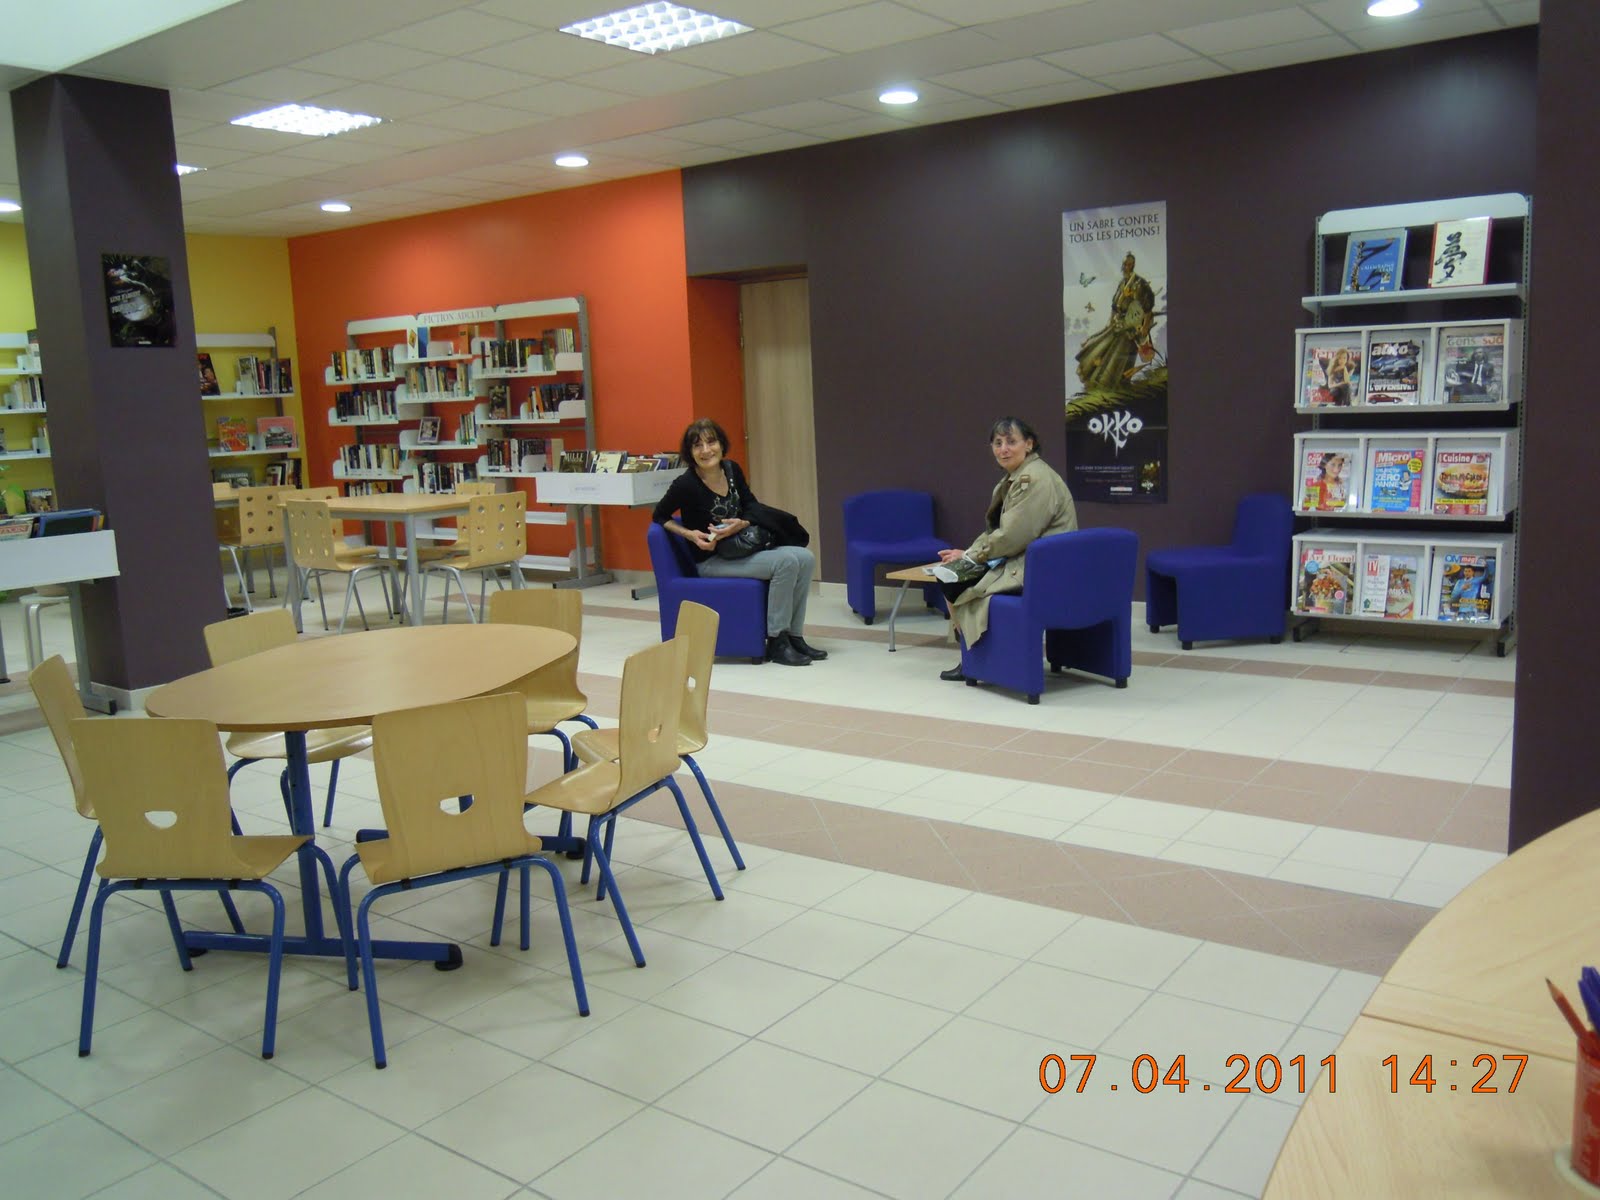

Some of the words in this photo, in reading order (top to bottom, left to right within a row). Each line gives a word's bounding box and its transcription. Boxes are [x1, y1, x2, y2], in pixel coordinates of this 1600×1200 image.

[1069, 221, 1085, 232] UN
[1087, 218, 1115, 230] SABRE
[1117, 213, 1160, 227] CONTRE
[1070, 232, 1094, 243] TOUS
[1096, 230, 1112, 241] LES
[424, 313, 455, 324] FICTION
[457, 310, 486, 320] ADULTE
[1378, 452, 1409, 463] Micro
[1442, 454, 1471, 463] Cuisine
